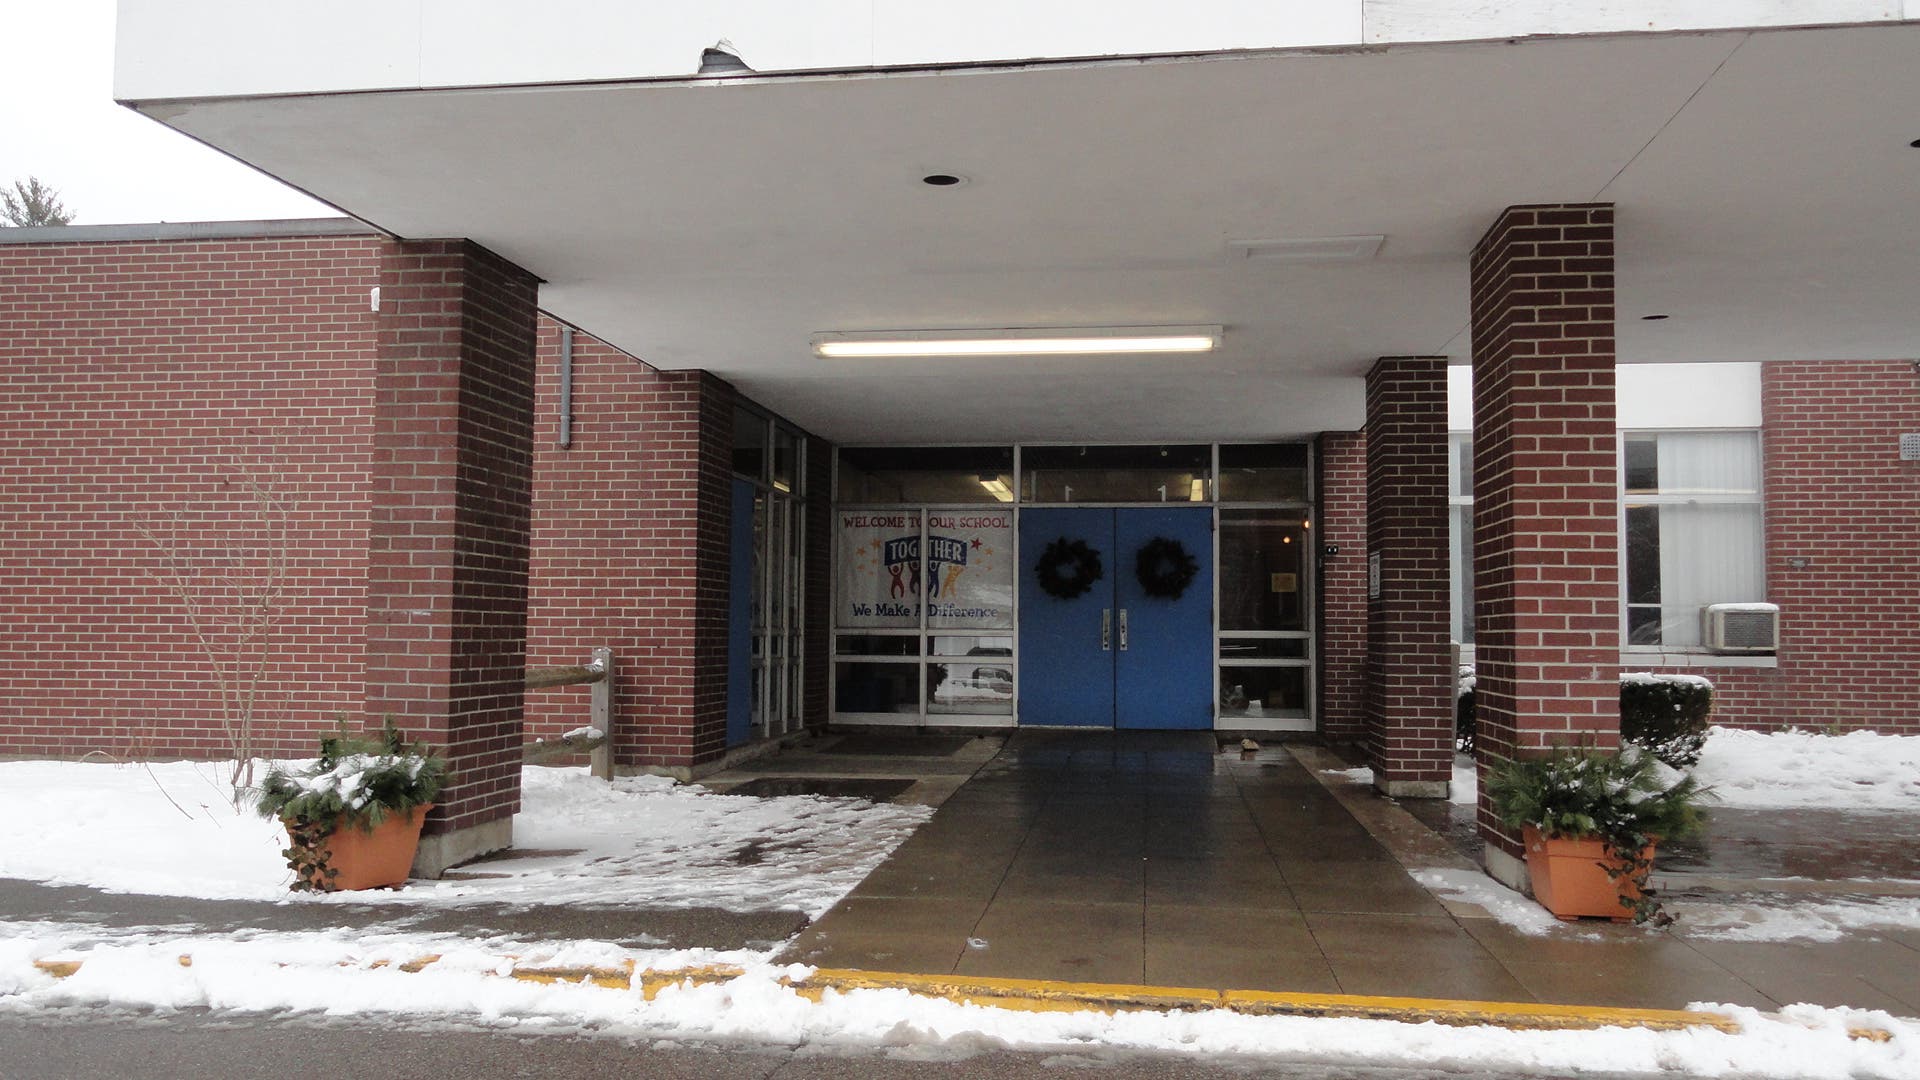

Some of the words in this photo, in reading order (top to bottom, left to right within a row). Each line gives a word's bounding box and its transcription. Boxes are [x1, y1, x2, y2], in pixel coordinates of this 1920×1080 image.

[844, 516, 905, 528] WELCOME
[929, 516, 956, 529] OUR
[960, 517, 1009, 528] SCHOOL
[890, 539, 962, 561] TOGTHER
[852, 603, 872, 616] We
[928, 603, 998, 617] Difference
